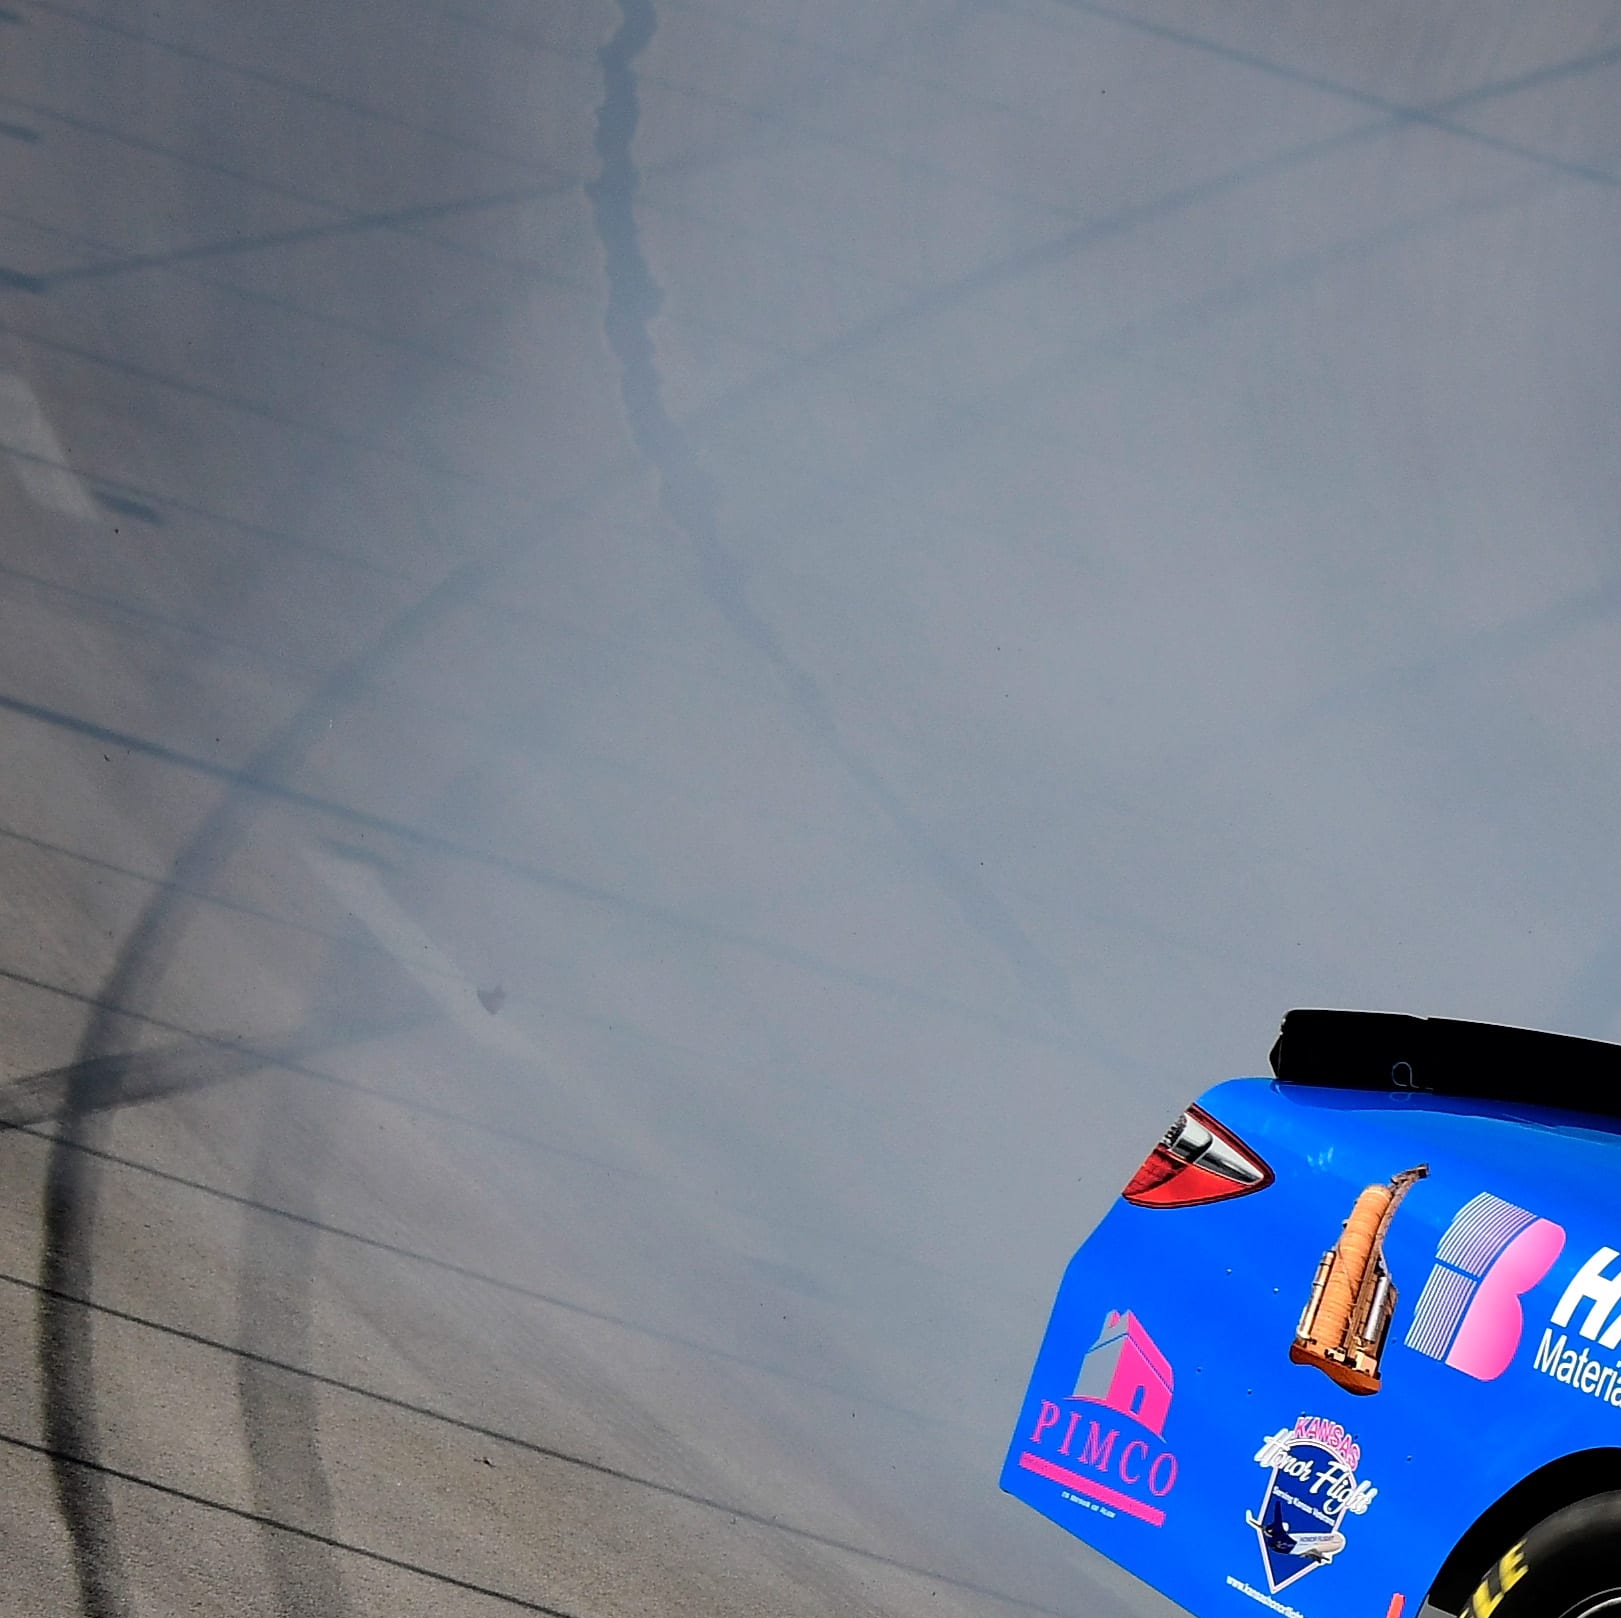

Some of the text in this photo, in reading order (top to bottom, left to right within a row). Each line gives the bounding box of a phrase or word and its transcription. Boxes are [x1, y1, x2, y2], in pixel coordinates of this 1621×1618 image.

[1030, 1400, 1179, 1497] PIMCO
[1254, 1428, 1378, 1515] Honor Flight
[1293, 1416, 1360, 1472] KANSAS
